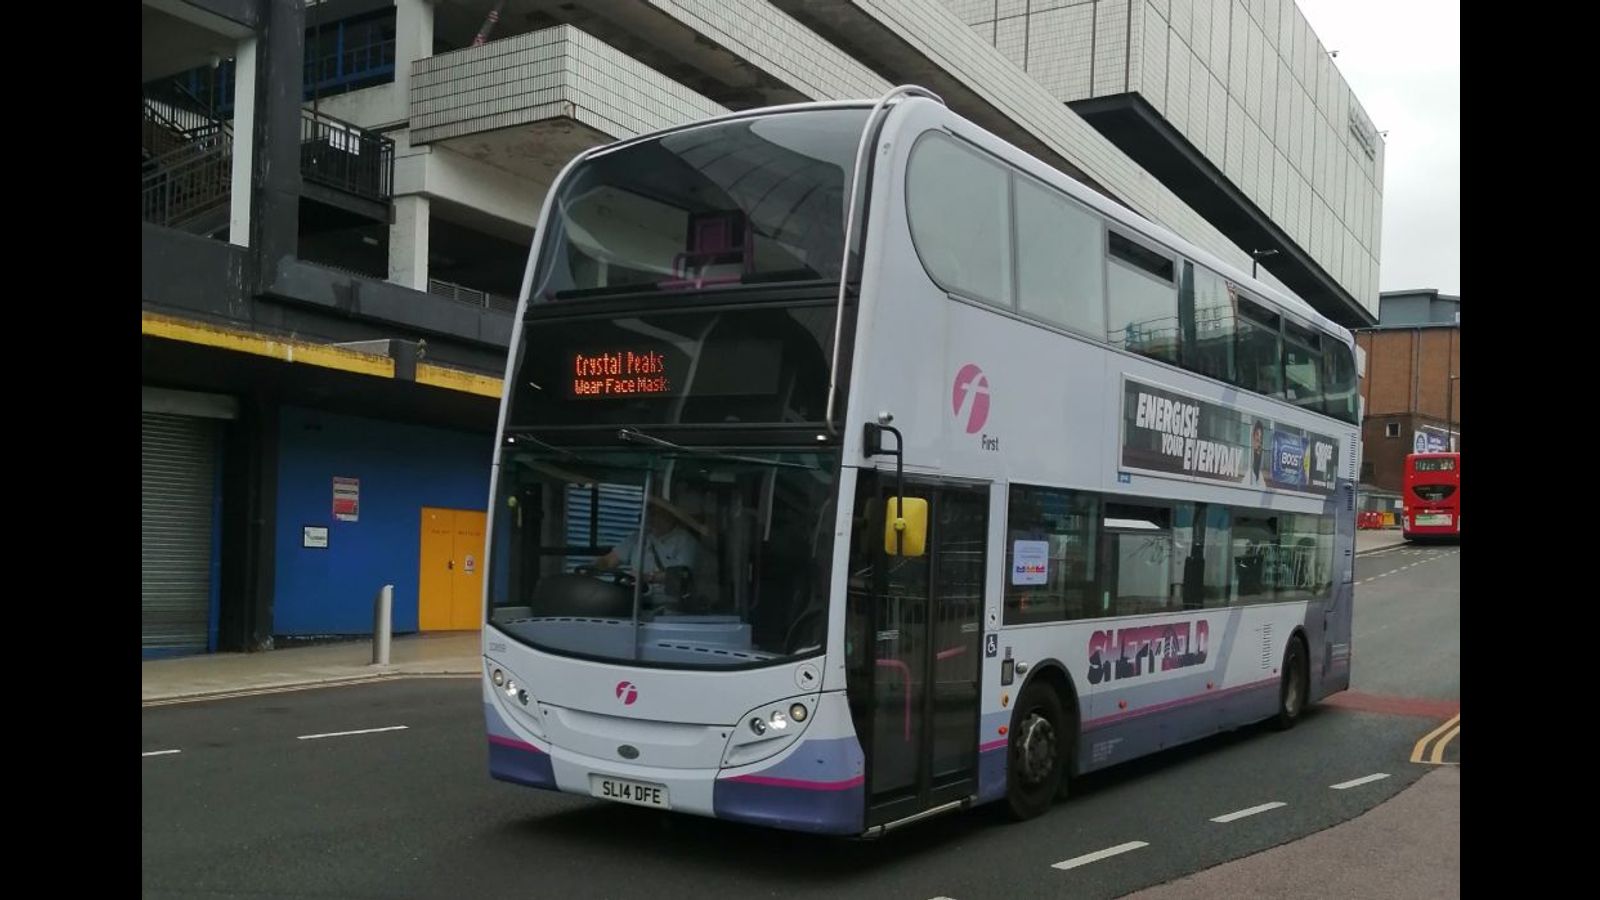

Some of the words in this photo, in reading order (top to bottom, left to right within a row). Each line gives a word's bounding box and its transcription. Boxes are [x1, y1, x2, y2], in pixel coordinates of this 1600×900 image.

[576, 352, 621, 376] Crystal
[627, 350, 664, 374] Peaks
[574, 379, 603, 394] Wear
[605, 378, 635, 394] Face
[1136, 392, 1200, 439] ENERGISE
[981, 434, 999, 451] First
[1161, 433, 1184, 457] YOUR
[1183, 438, 1243, 478] EVERYDAY
[1087, 619, 1209, 685] SHEFFIELD
[602, 780, 631, 799] SL14
[634, 785, 662, 804] DFE
